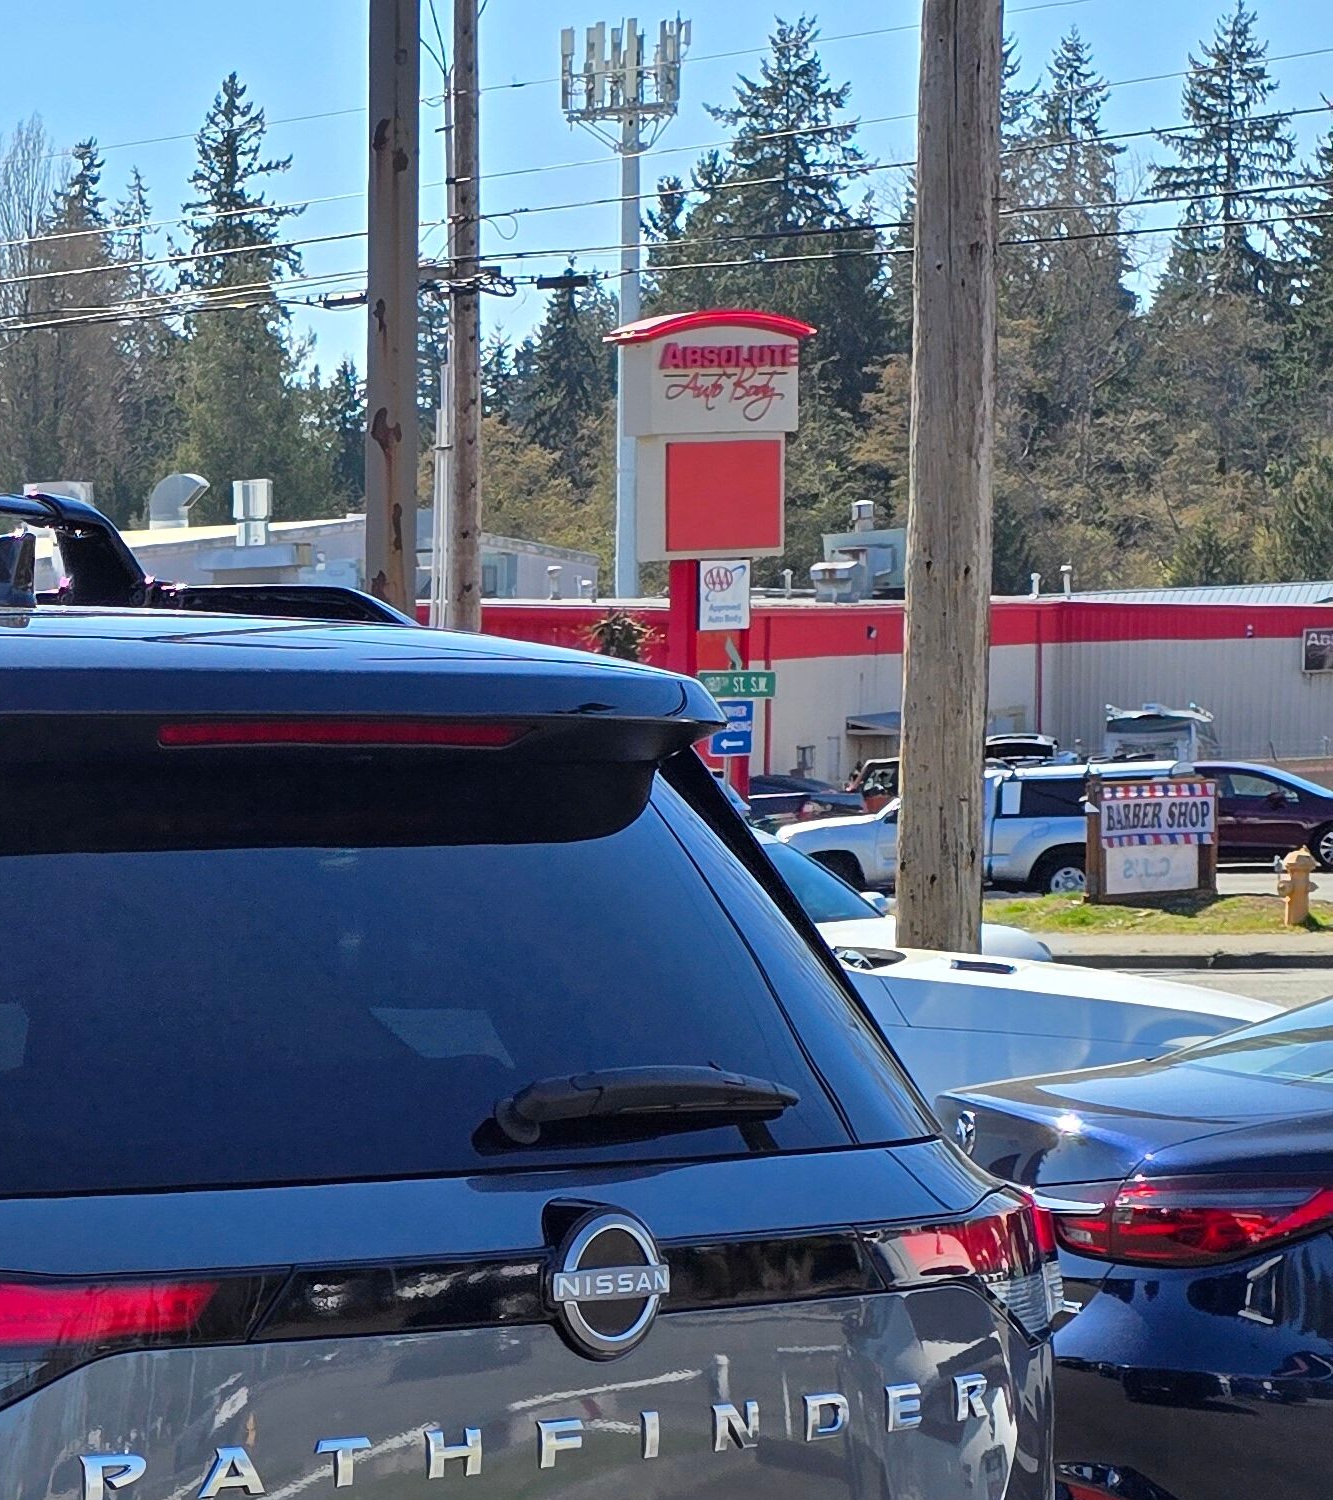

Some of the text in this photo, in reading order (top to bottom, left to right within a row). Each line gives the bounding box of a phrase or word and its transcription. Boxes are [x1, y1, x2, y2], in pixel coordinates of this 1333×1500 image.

[660, 342, 798, 369] ABSOLUTE
[1306, 632, 1333, 647] AB
[1106, 800, 1210, 831] BARBER SHOP
[558, 1268, 669, 1297] NISSAN
